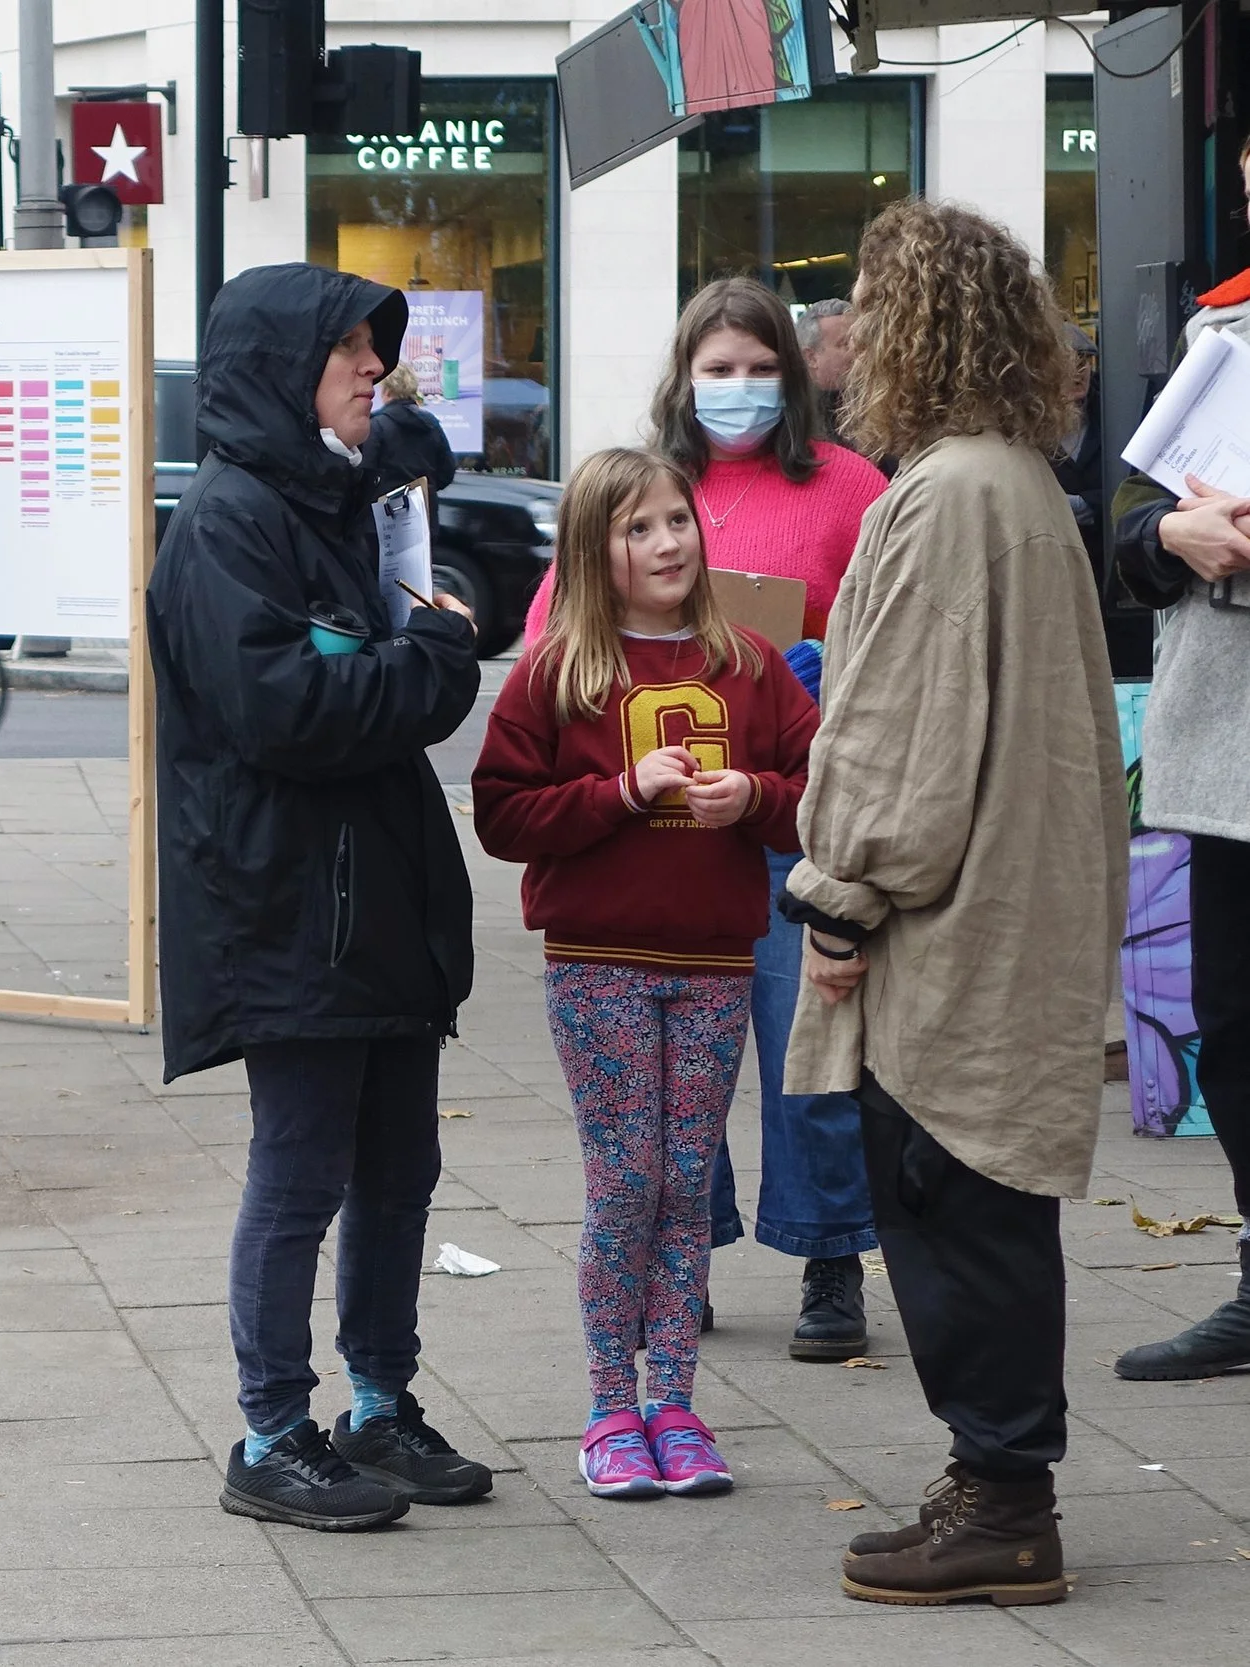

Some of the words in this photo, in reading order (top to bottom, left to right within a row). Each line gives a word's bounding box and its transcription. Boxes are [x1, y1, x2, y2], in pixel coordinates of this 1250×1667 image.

[346, 120, 505, 144] ANIC
[357, 146, 493, 170] COFFEE
[409, 305, 446, 316] PRET'S
[430, 316, 469, 326] LUNCH
[1177, 448, 1198, 474] Gardens
[492, 466, 527, 476] WRAPS
[620, 681, 729, 813] G
[649, 818, 719, 829] GRYFFIND
